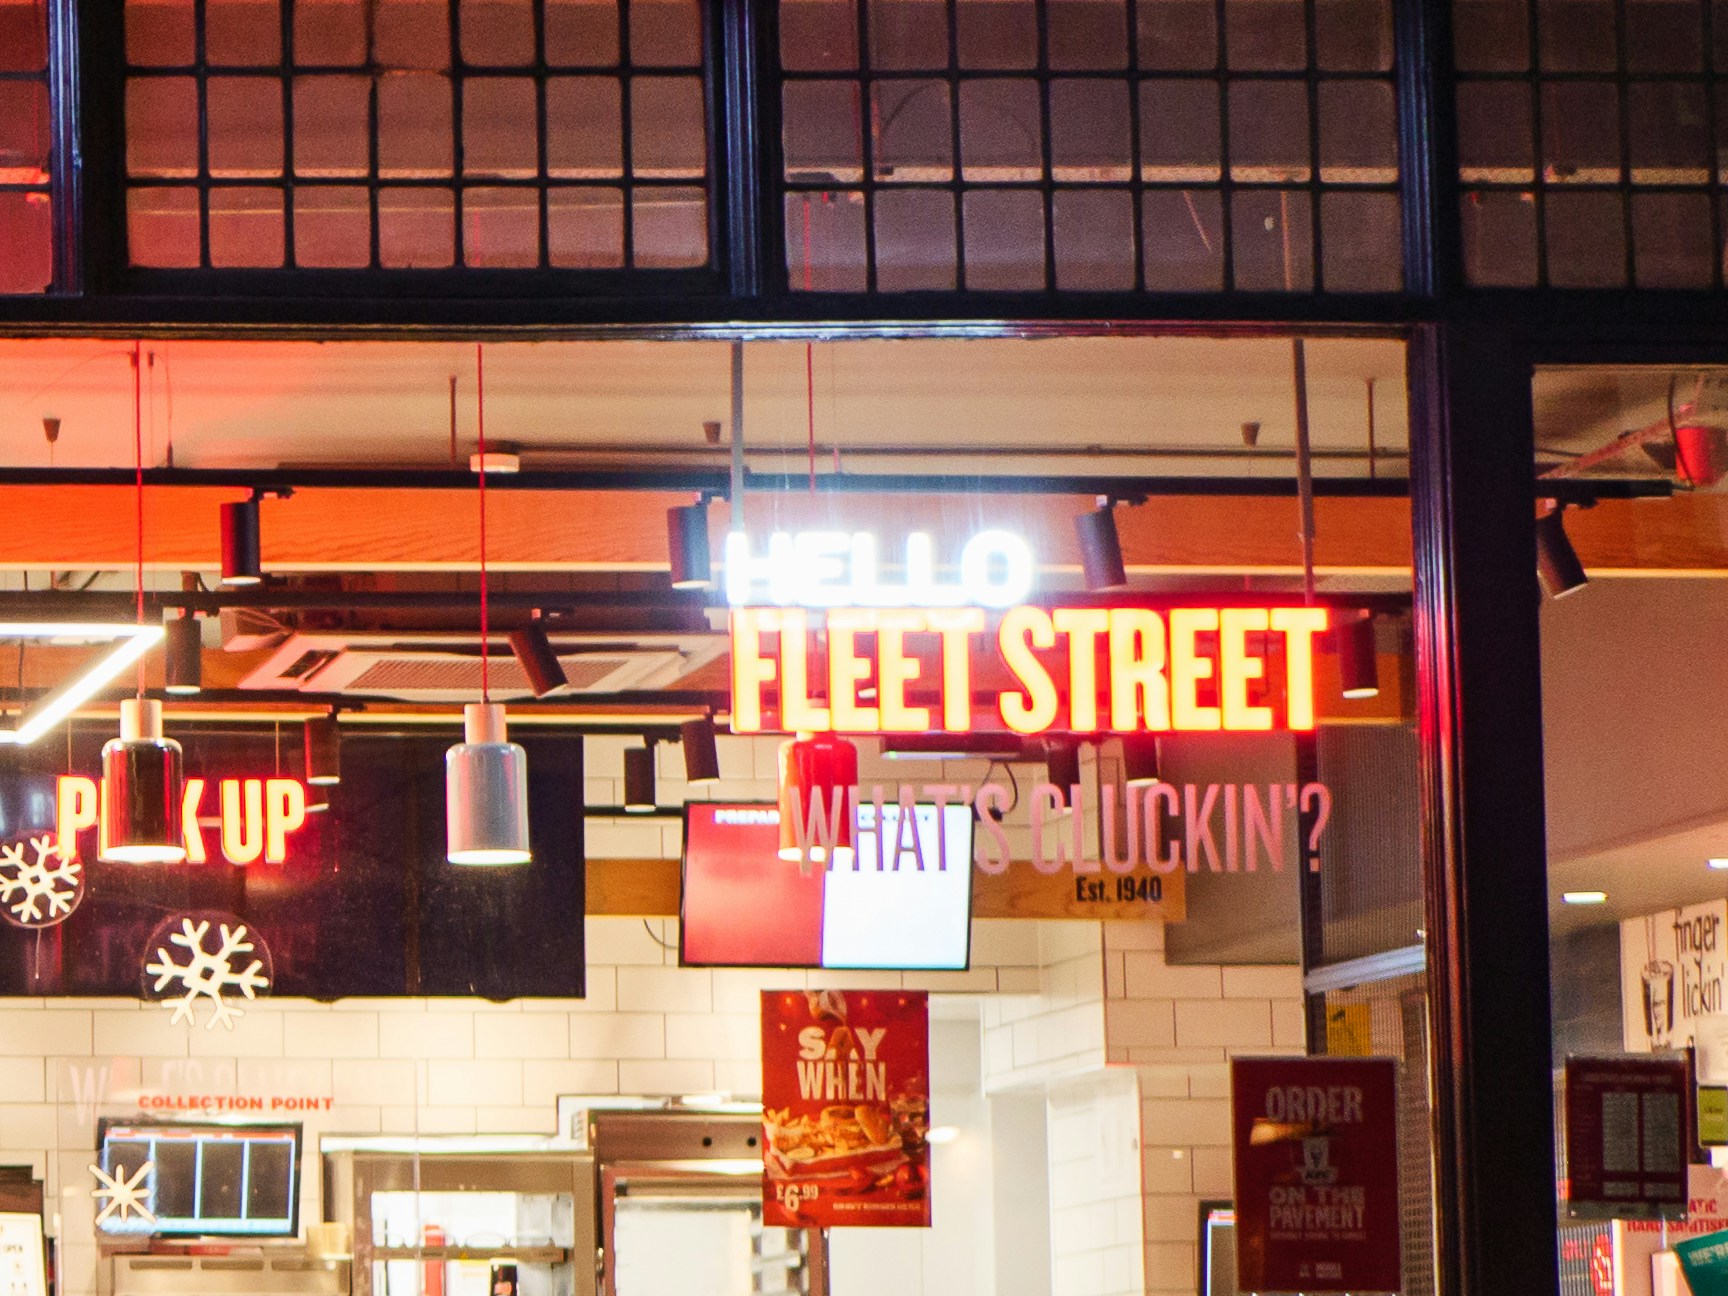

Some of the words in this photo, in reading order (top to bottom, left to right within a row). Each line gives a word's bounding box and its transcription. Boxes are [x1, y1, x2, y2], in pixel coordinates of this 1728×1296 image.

[724, 530, 1036, 608] HELLO
[730, 605, 986, 734] FLEET
[997, 604, 1330, 735] STREET
[56, 774, 207, 865] PK
[219, 777, 306, 866] UP
[788, 782, 1011, 876] WHAT'S
[1030, 781, 1332, 876] CLUCKIN'?
[1075, 875, 1111, 903] Est.
[1116, 875, 1162, 902] 1940
[796, 1060, 887, 1102] WHEN
[138, 1095, 263, 1110] COLLECTION
[271, 1096, 334, 1111] POINT
[1265, 1085, 1364, 1123] ORDER
[1269, 1186, 1306, 1204] ON
[1269, 1204, 1365, 1229] PAVEMENT
